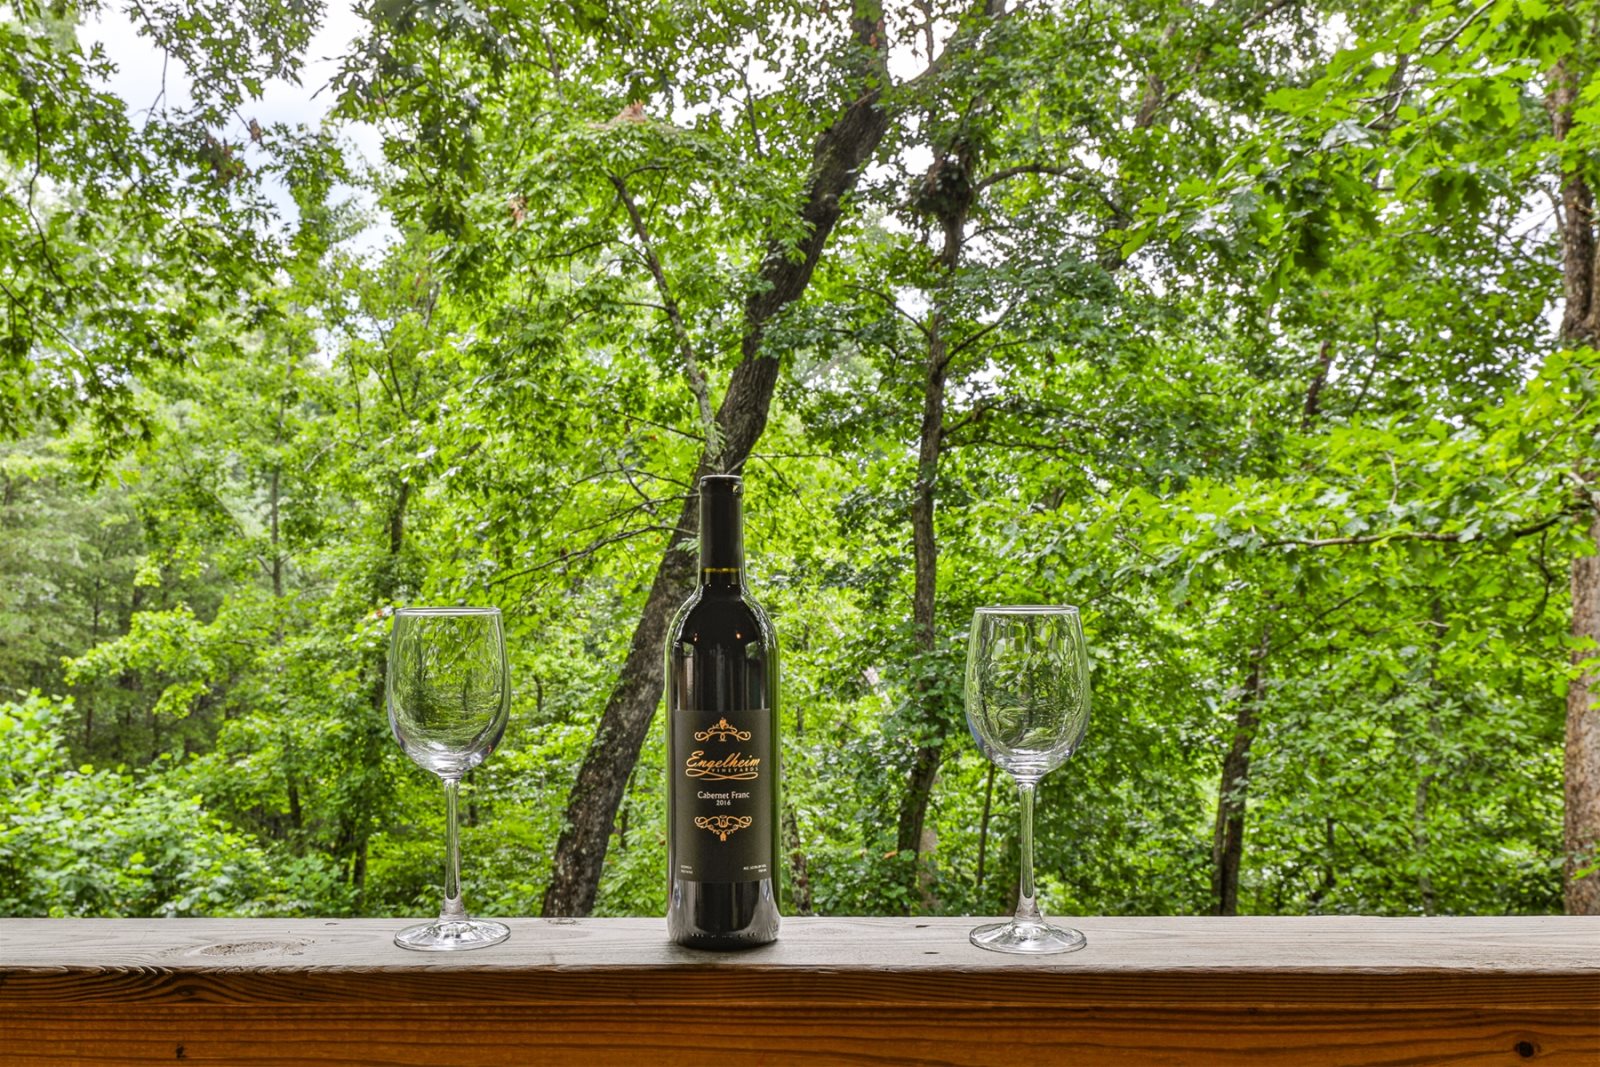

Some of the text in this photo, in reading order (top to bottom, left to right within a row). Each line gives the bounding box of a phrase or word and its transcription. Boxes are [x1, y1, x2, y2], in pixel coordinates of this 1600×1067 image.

[686, 750, 760, 771] Engelheim
[697, 790, 750, 799] Cabernet Franc
